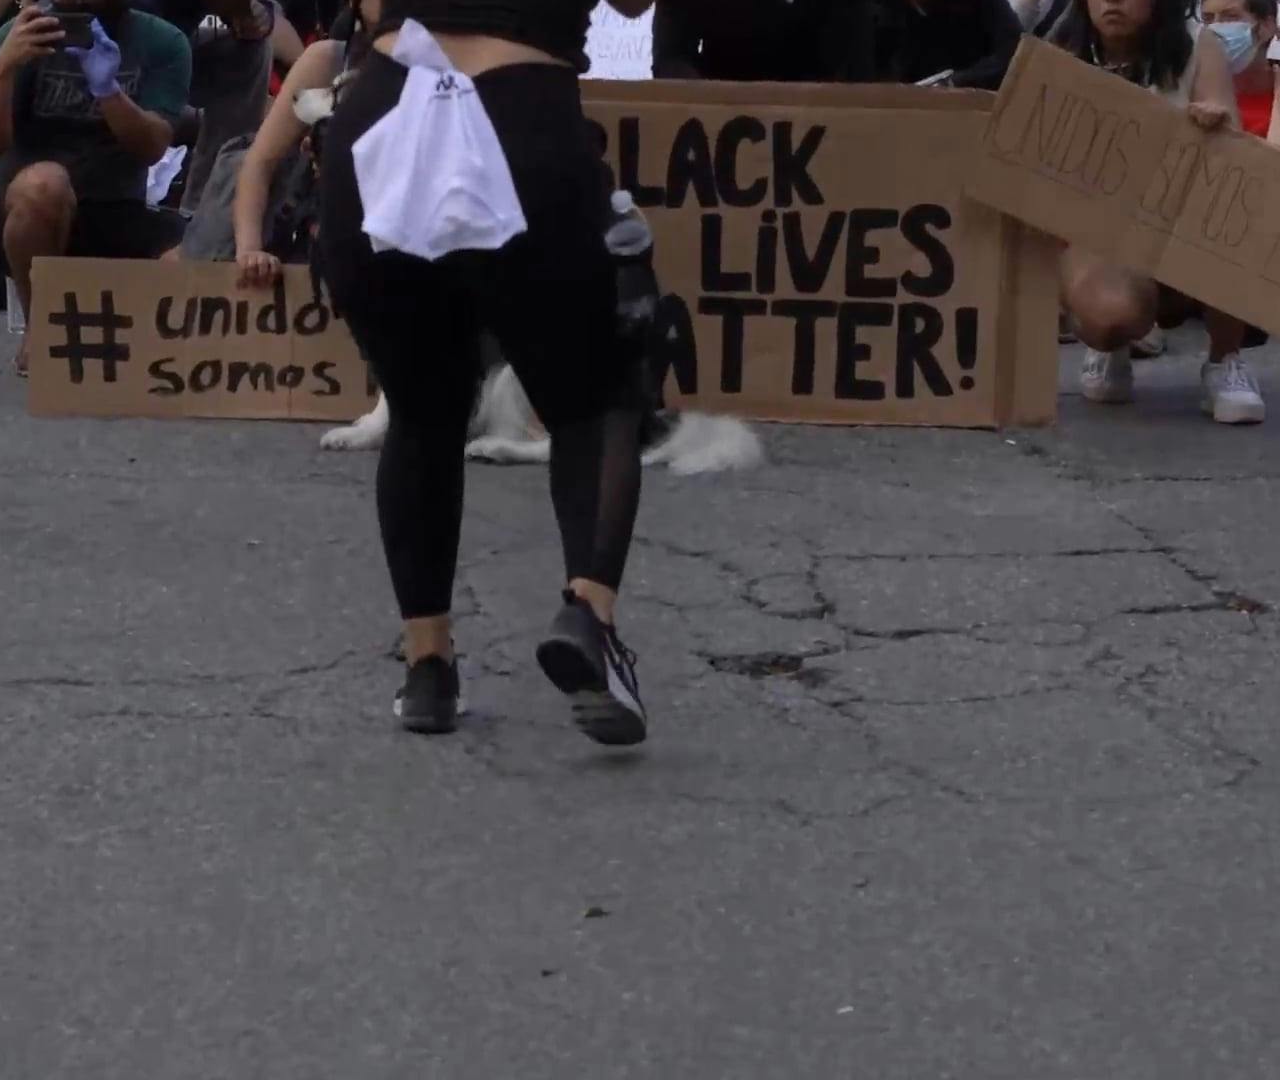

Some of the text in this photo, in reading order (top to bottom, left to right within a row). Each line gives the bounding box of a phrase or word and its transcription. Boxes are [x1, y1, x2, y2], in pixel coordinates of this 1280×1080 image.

[596, 115, 827, 209] LACK
[1138, 139, 1264, 249] SOMOS
[154, 271, 332, 341] unido
[658, 292, 980, 401] ATTER!
[147, 356, 342, 397] somos
